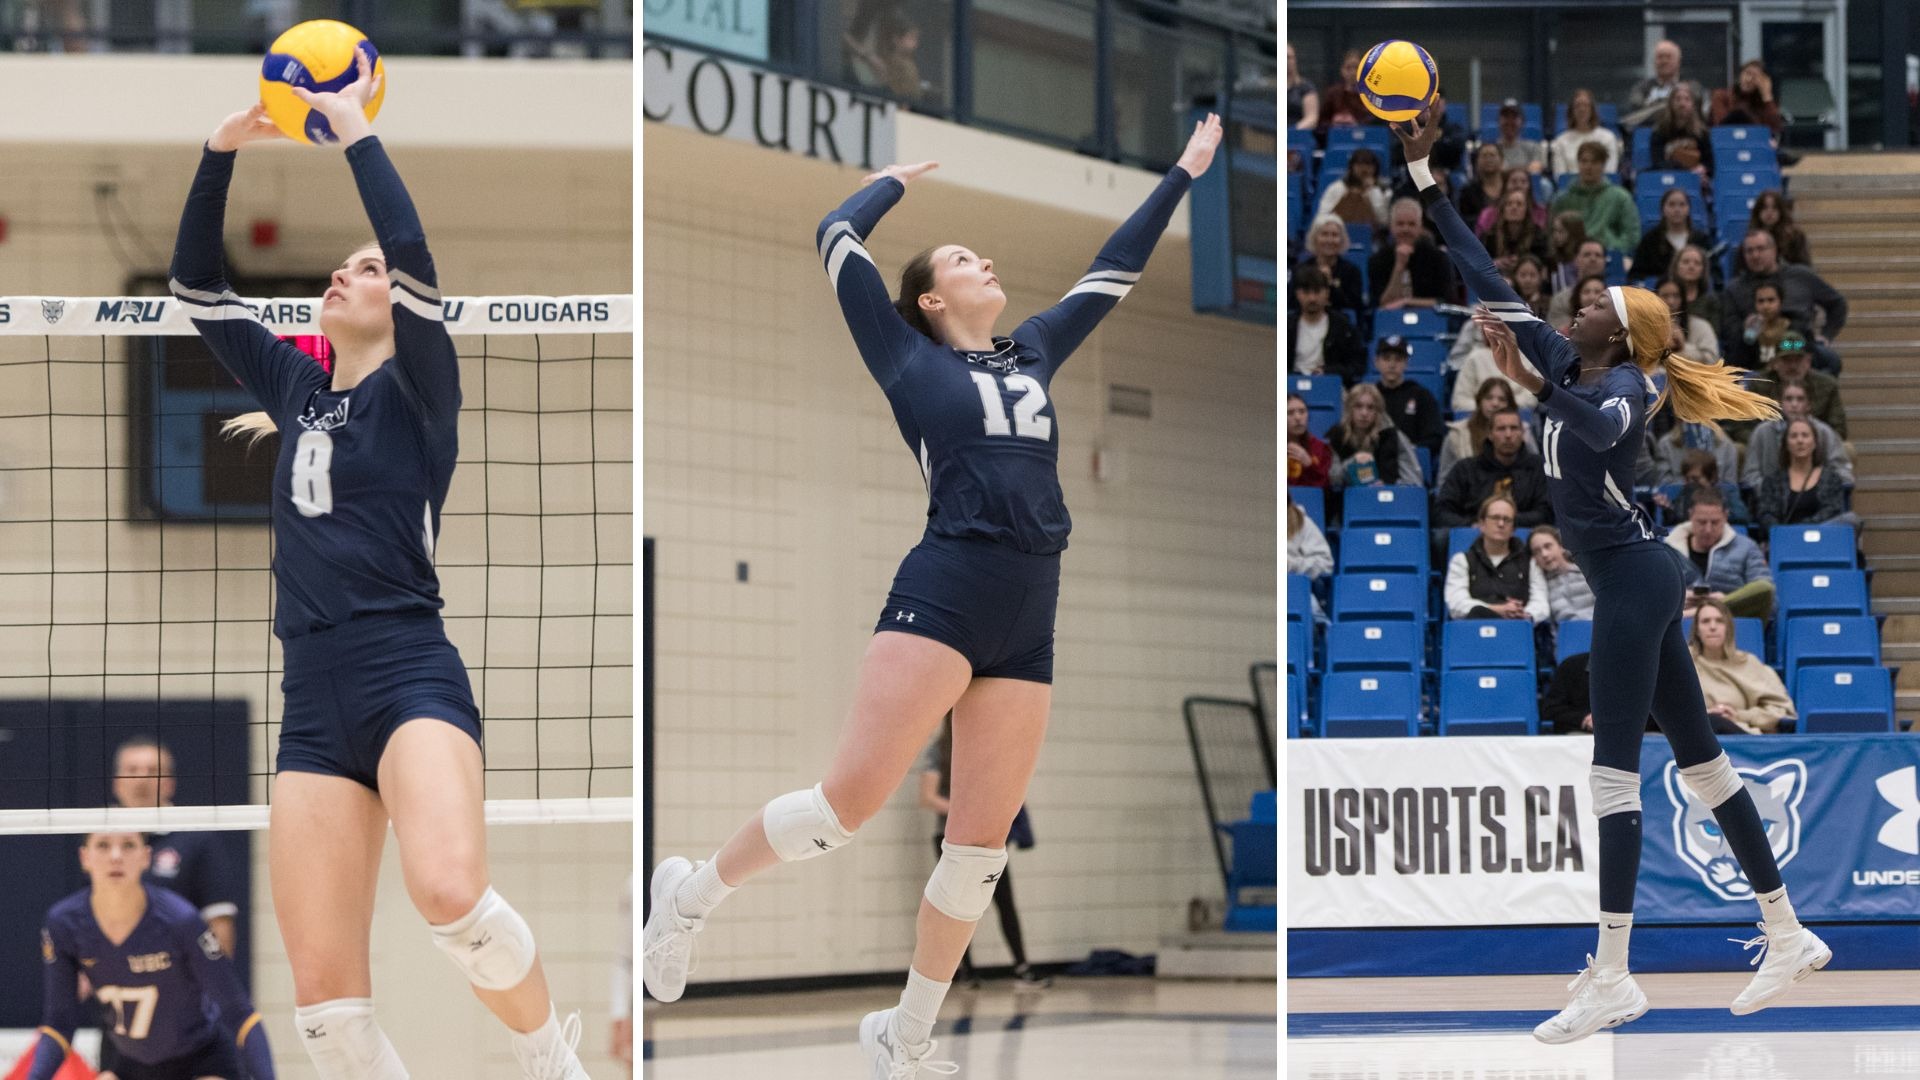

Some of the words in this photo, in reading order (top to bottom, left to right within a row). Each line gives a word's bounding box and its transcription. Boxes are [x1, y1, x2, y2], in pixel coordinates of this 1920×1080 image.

[643, 44, 886, 170] COURT
[95, 301, 166, 323] MRU
[489, 302, 609, 322] COUGARS
[969, 370, 1051, 442] 12
[291, 429, 333, 518] 8
[1304, 785, 1584, 877] USPORTS.CA
[1853, 870, 1920, 886] UNDE
[97, 984, 159, 1040] 17
